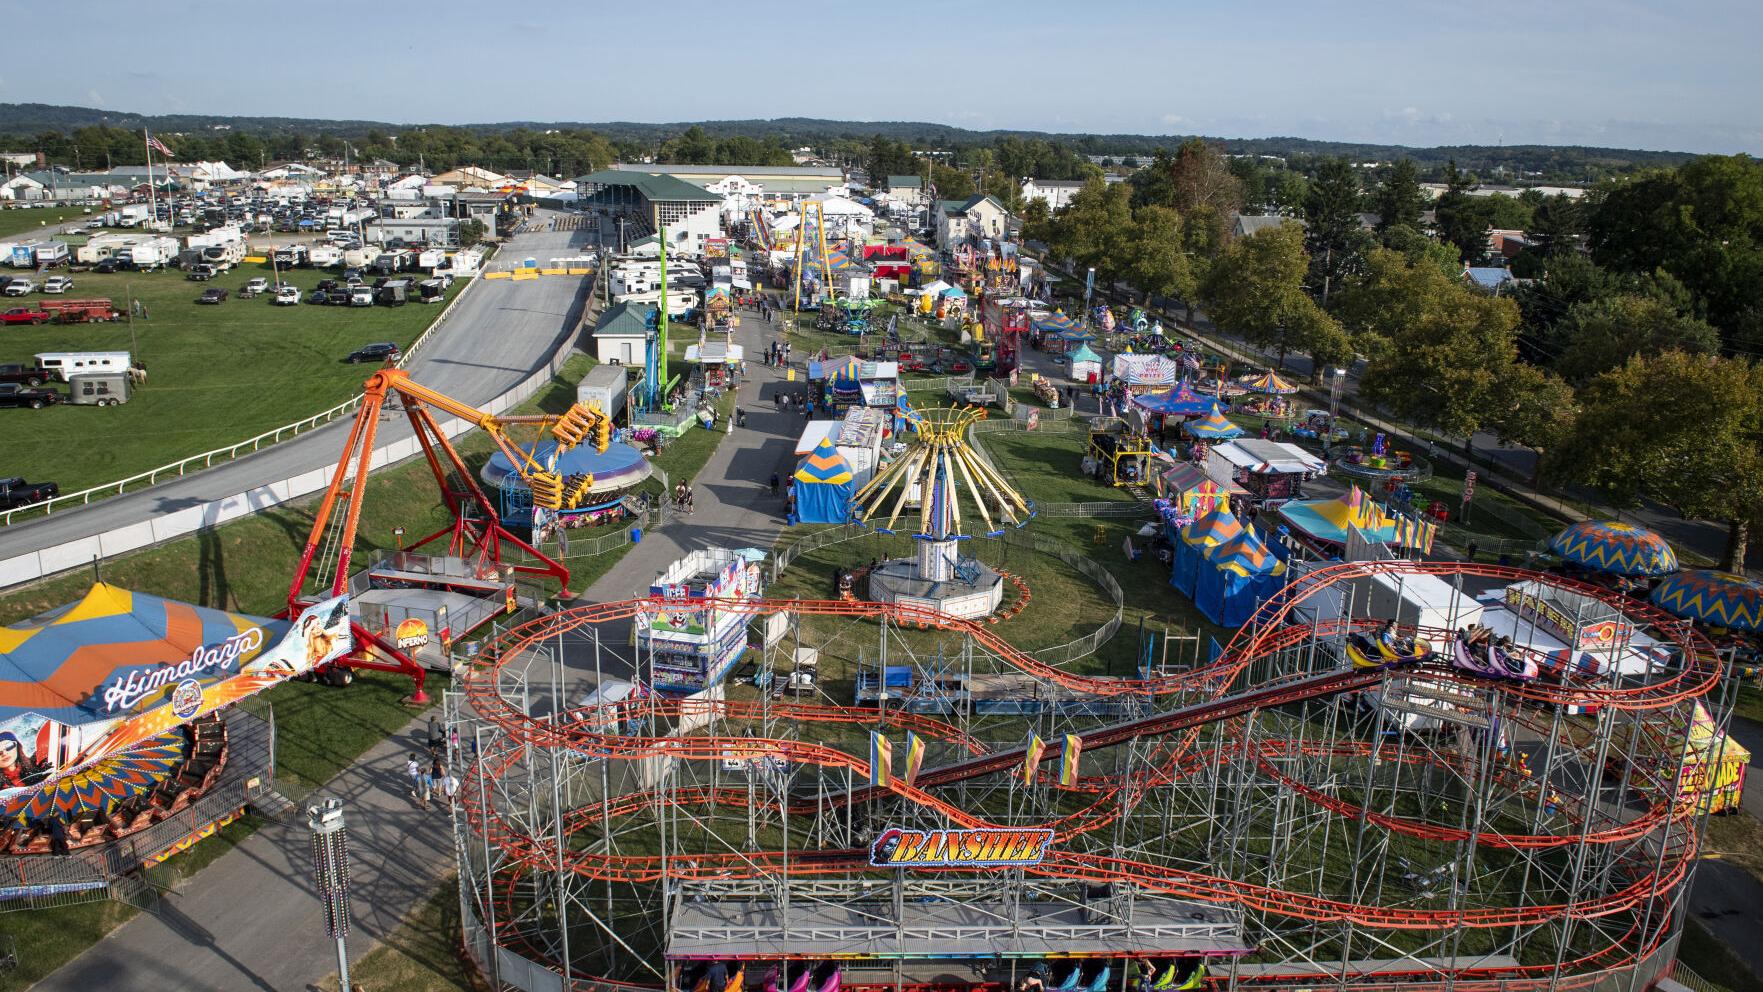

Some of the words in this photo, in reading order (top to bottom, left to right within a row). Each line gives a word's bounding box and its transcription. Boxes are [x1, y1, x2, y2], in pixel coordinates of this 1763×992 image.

[397, 634, 429, 649] INFERNO
[105, 627, 263, 712] Himalaya
[888, 832, 1050, 862] BANSHEE
